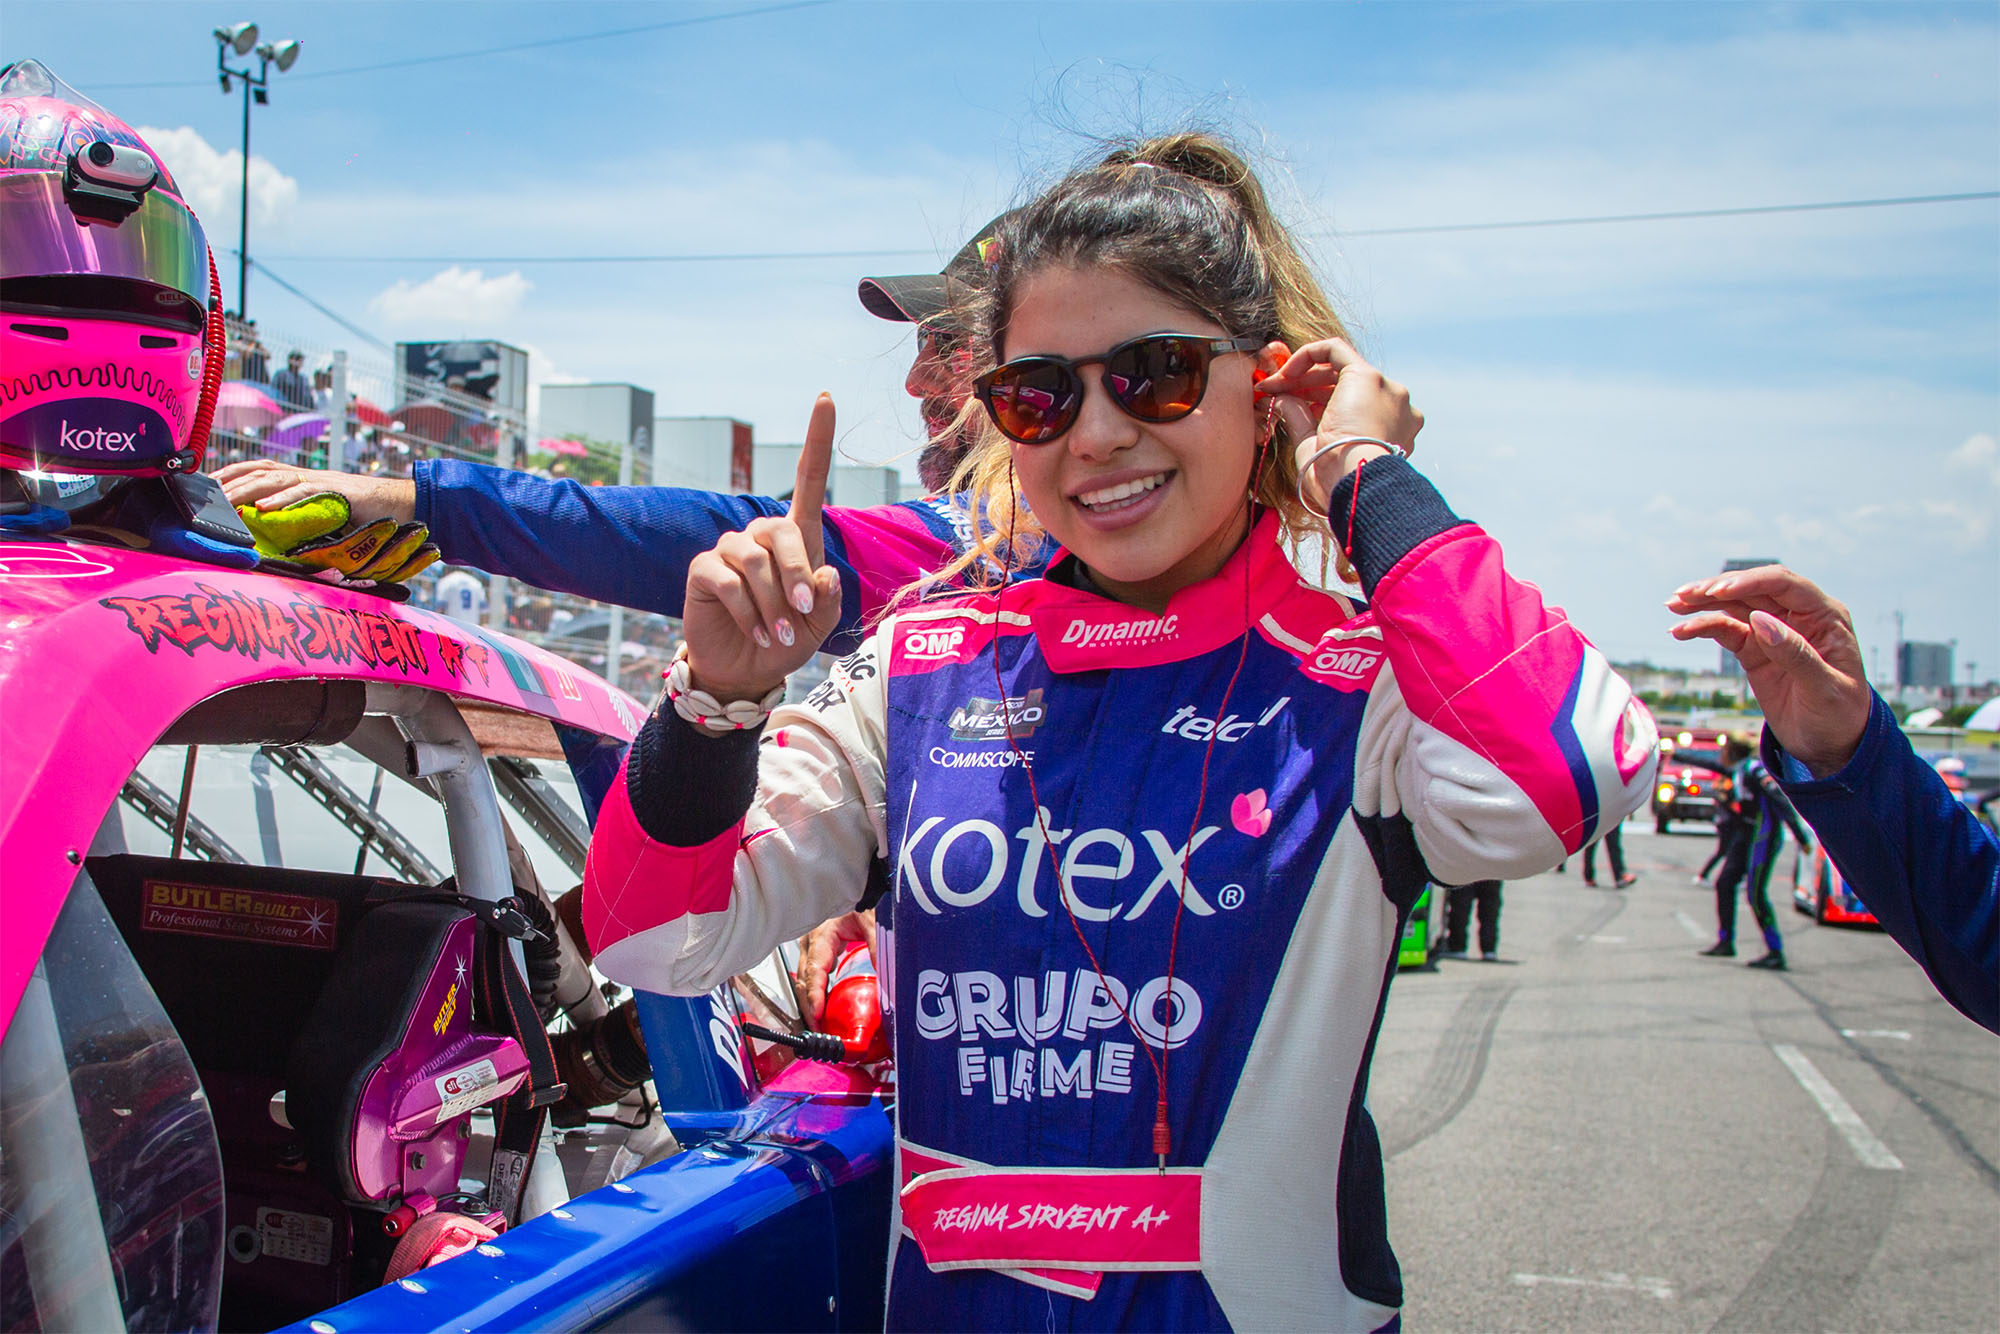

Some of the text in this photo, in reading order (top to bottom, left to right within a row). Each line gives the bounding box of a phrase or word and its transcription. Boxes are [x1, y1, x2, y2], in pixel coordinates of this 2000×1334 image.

[60, 419, 137, 452] kotex
[350, 537, 377, 561] OMP
[100, 582, 306, 666] REGINA
[291, 592, 429, 677] SIRVENT
[904, 631, 964, 655] OMP
[1061, 614, 1179, 649] Dynamic
[1089, 633, 1180, 649] motorsports
[1315, 652, 1378, 675] OMP
[895, 778, 1222, 922] kotex
[151, 884, 301, 919] BUTLER BUILT
[149, 910, 222, 929] Professional
[253, 921, 299, 938] Systems
[433, 983, 457, 1034] BUTLER
[916, 967, 1203, 1050] GRUPO
[957, 1040, 1136, 1105] FIRME
[933, 1202, 1172, 1235] REGINA SIRVENT A+
